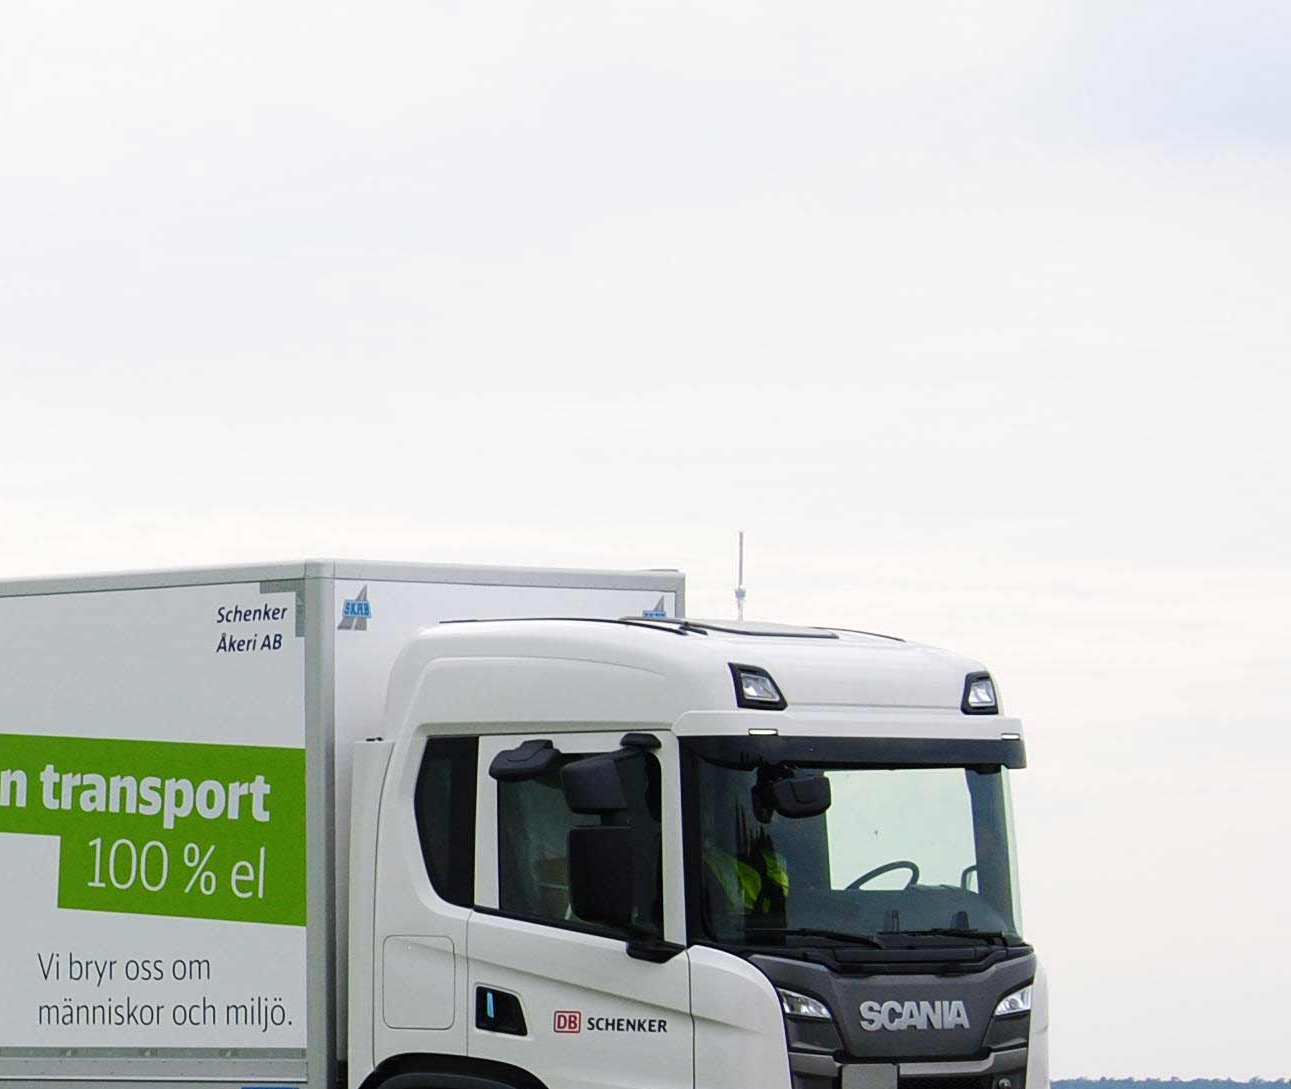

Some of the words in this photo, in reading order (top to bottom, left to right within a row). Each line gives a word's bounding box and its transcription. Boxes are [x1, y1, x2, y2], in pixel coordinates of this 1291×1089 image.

[216, 603, 288, 624] Schenker
[343, 601, 370, 616] SKAB
[216, 632, 258, 653] Åkeri
[260, 633, 283, 650] AB
[40, 764, 271, 829] transport
[87, 837, 169, 892] 100
[183, 842, 218, 896] %
[230, 846, 266, 899] el
[37, 953, 60, 981] Vi
[69, 953, 117, 987] bryr
[124, 960, 164, 981] oss
[171, 959, 211, 981] om
[38, 997, 165, 1026] människor
[172, 997, 217, 1026] och
[225, 997, 293, 1032] miljö.
[557, 1014, 578, 1030] DB
[587, 1017, 668, 1034] SCHENKER
[859, 1000, 970, 1032] SCANIA
